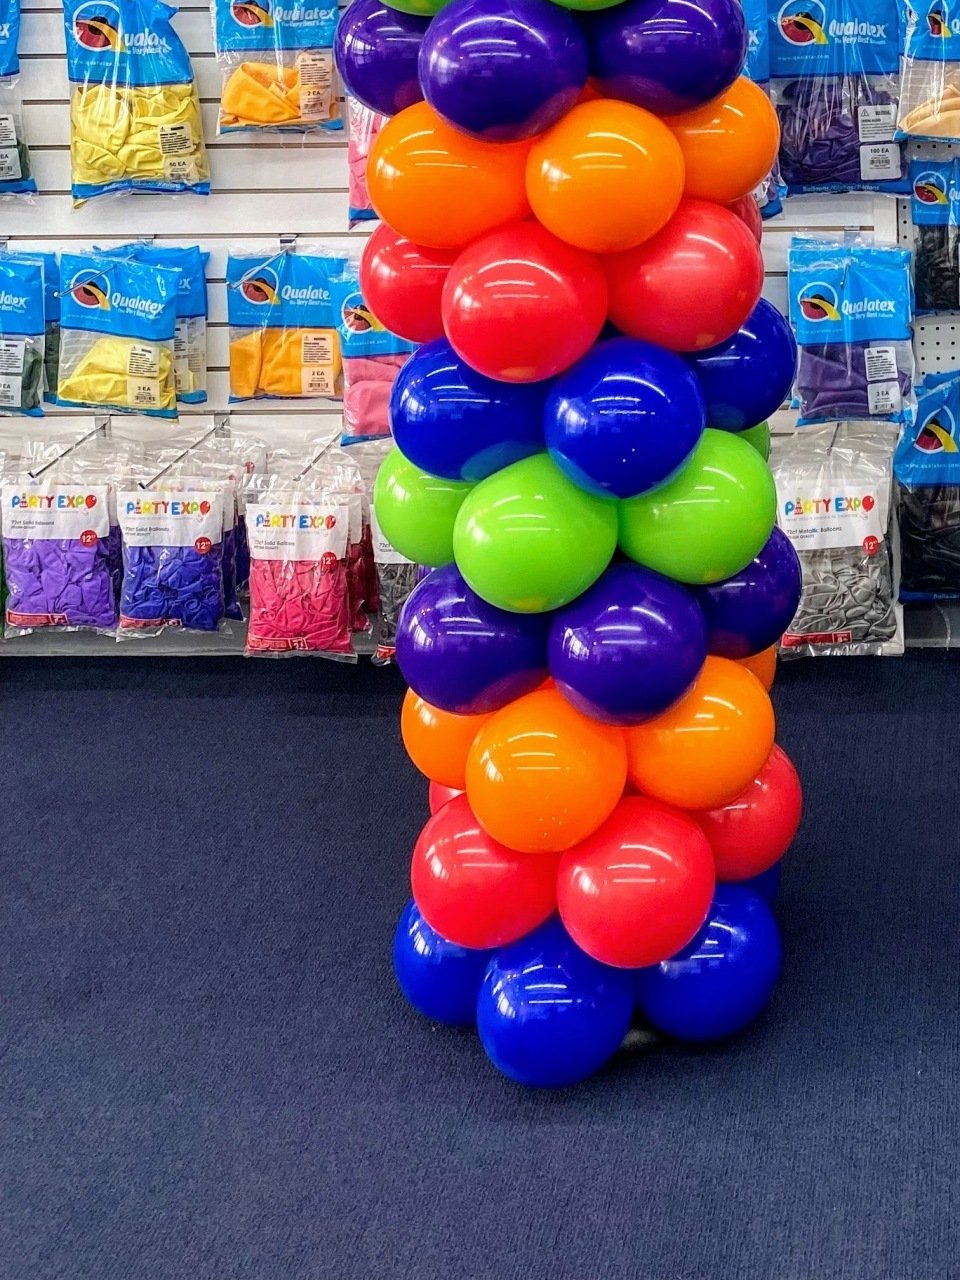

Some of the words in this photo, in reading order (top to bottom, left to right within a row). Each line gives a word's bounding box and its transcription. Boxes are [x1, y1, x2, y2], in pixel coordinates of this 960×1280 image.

[273, 6, 335, 22] Qualatex
[829, 17, 886, 37] Qualatex
[111, 291, 165, 315] Qualatex
[297, 299, 307, 307] Very
[841, 299, 895, 313] Qualatex
[12, 493, 54, 508] PARTY
[58, 494, 97, 509] EXPO
[127, 498, 169, 515] PARTY
[172, 500, 211, 515] EXPO
[785, 497, 831, 515] PARTY
[835, 495, 874, 512] EXPO
[256, 511, 296, 528] PARTY
[299, 515, 336, 530] EXPO
[82, 534, 96, 543] 12"
[196, 541, 210, 550] 12"
[864, 540, 877, 550] 12"
